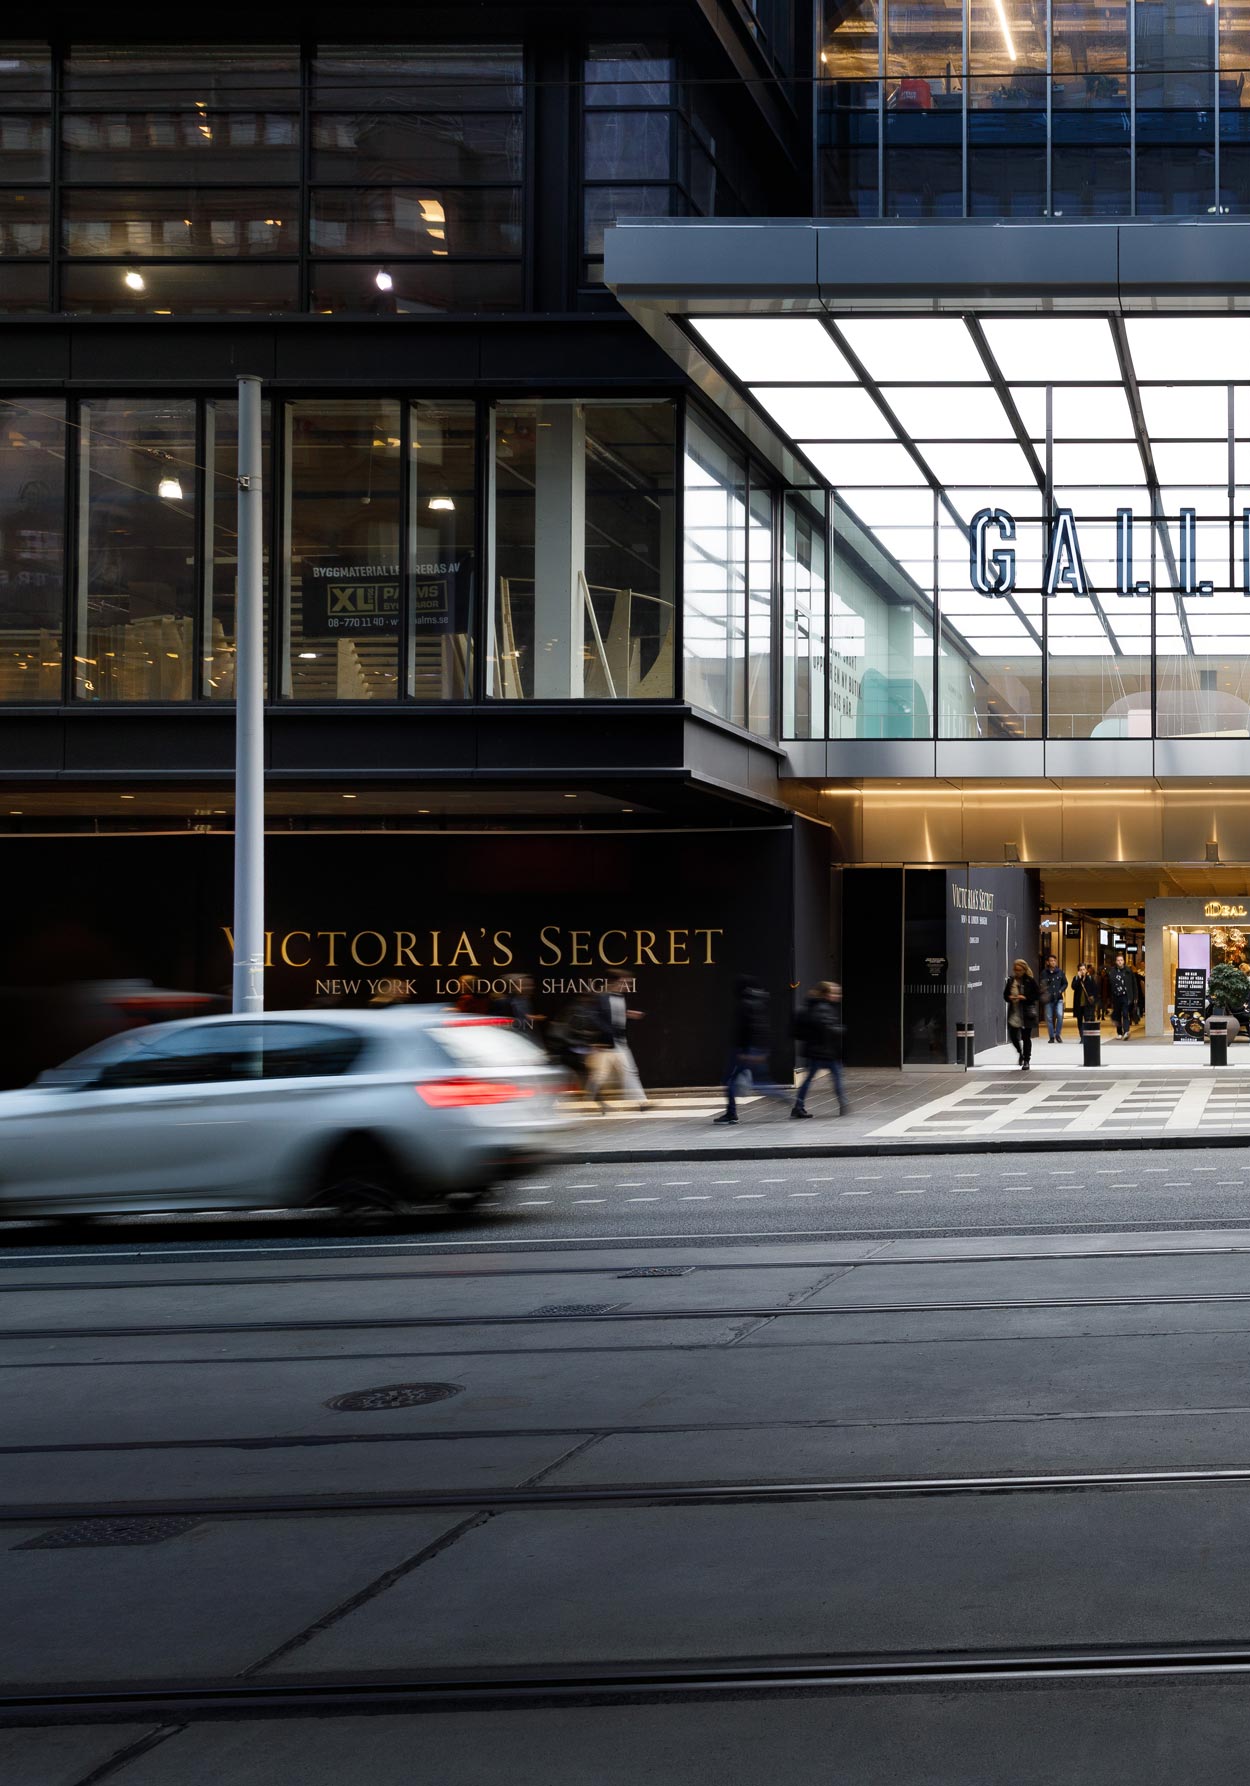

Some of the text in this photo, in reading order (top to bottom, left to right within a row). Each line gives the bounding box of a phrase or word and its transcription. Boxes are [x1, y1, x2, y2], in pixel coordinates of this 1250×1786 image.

[313, 562, 460, 578] BYGGMATERIAL LERERAS AV
[332, 588, 374, 611] XL
[384, 586, 438, 599] PMS
[384, 601, 439, 610] BYAROR
[328, 618, 360, 627] 08-770
[539, 925, 724, 967] SECRET
[316, 979, 362, 995] NEW
[367, 979, 417, 995] YORK
[436, 978, 523, 994] LONDON
